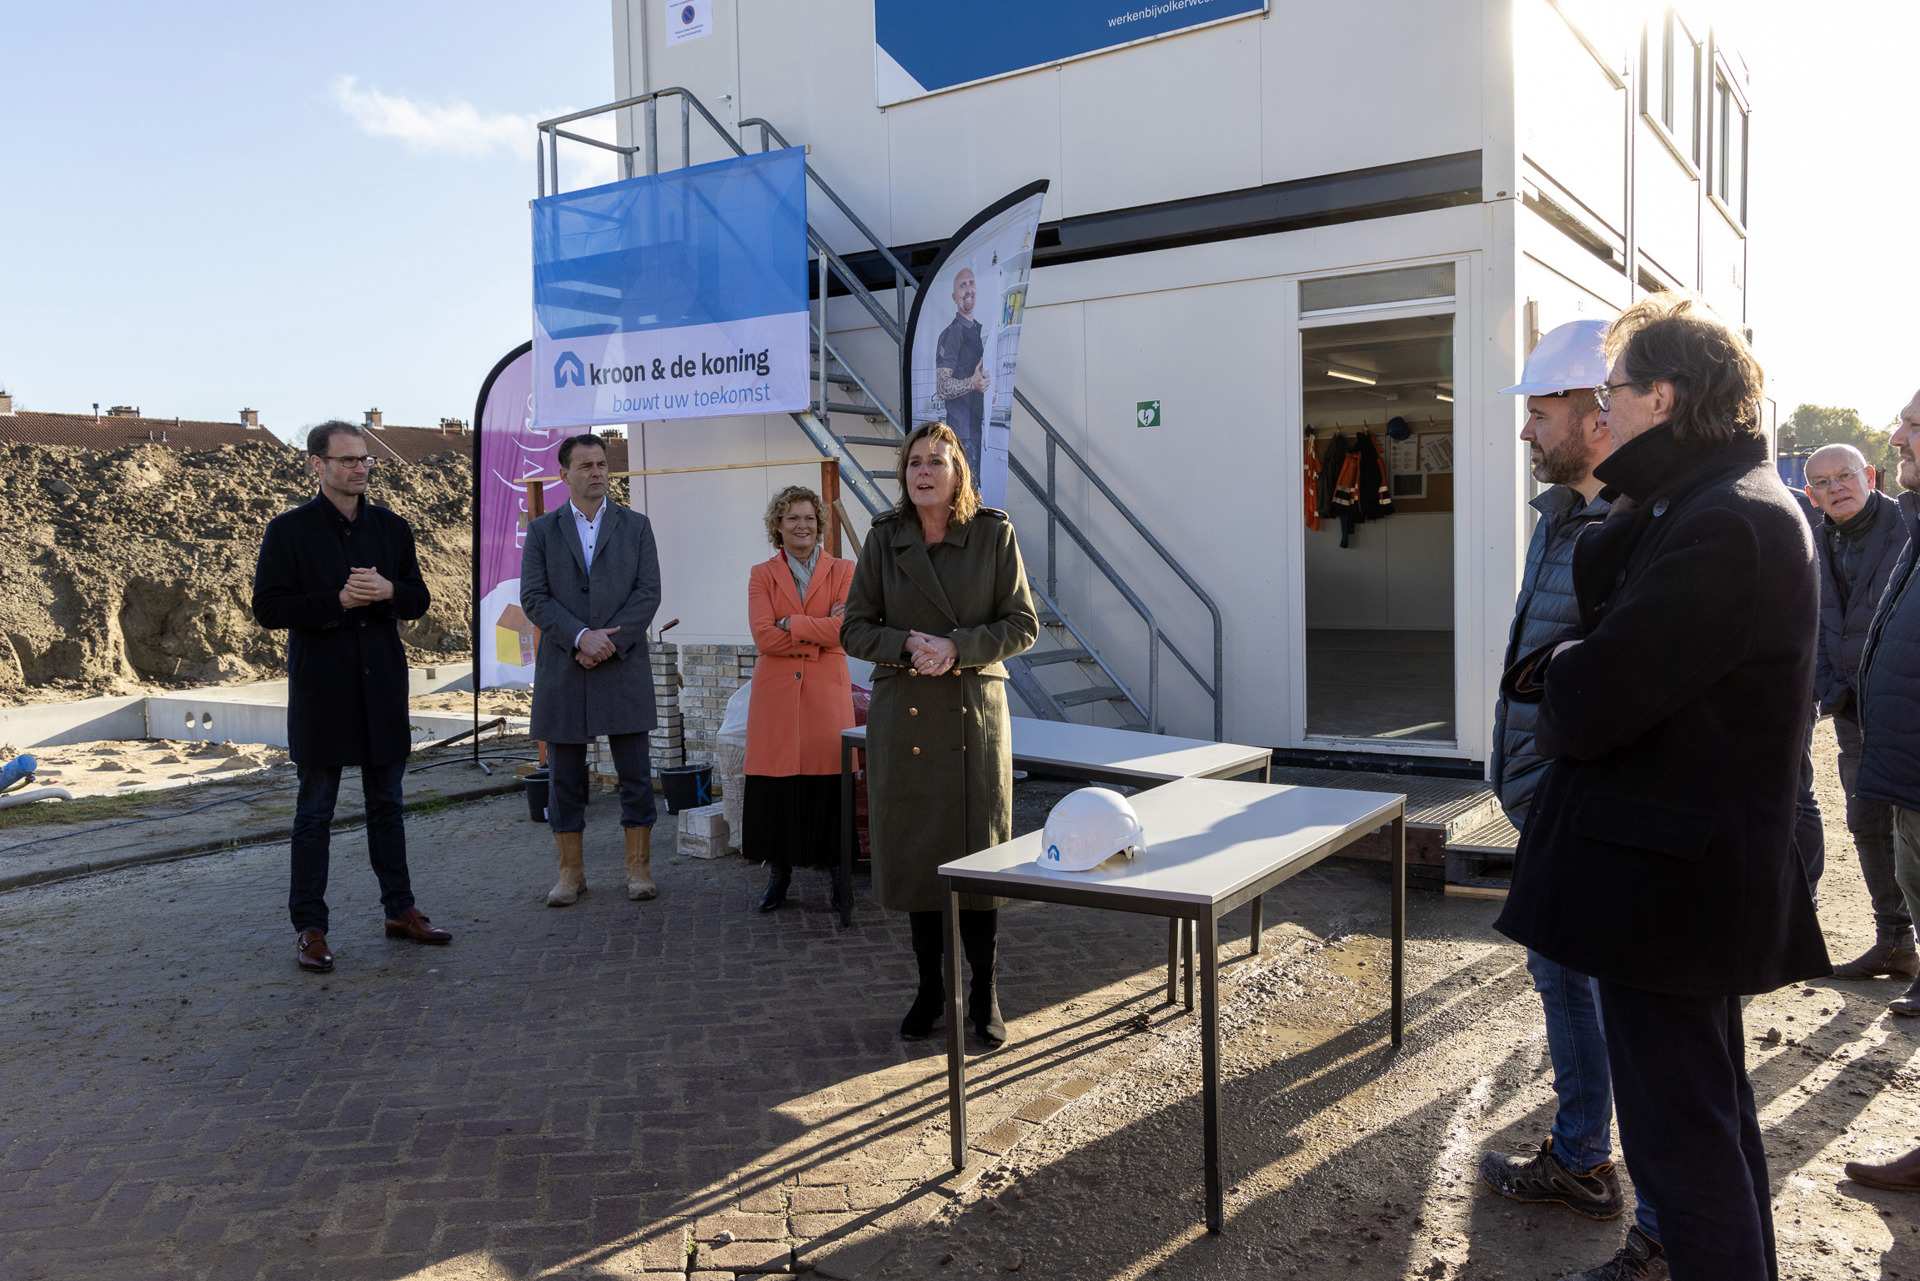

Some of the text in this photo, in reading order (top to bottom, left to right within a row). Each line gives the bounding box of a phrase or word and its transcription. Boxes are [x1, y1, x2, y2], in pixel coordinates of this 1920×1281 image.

[590, 348, 771, 386] kroon & de koning
[613, 383, 771, 413] bouwt uw toekomst
[695, 774, 712, 807] K
